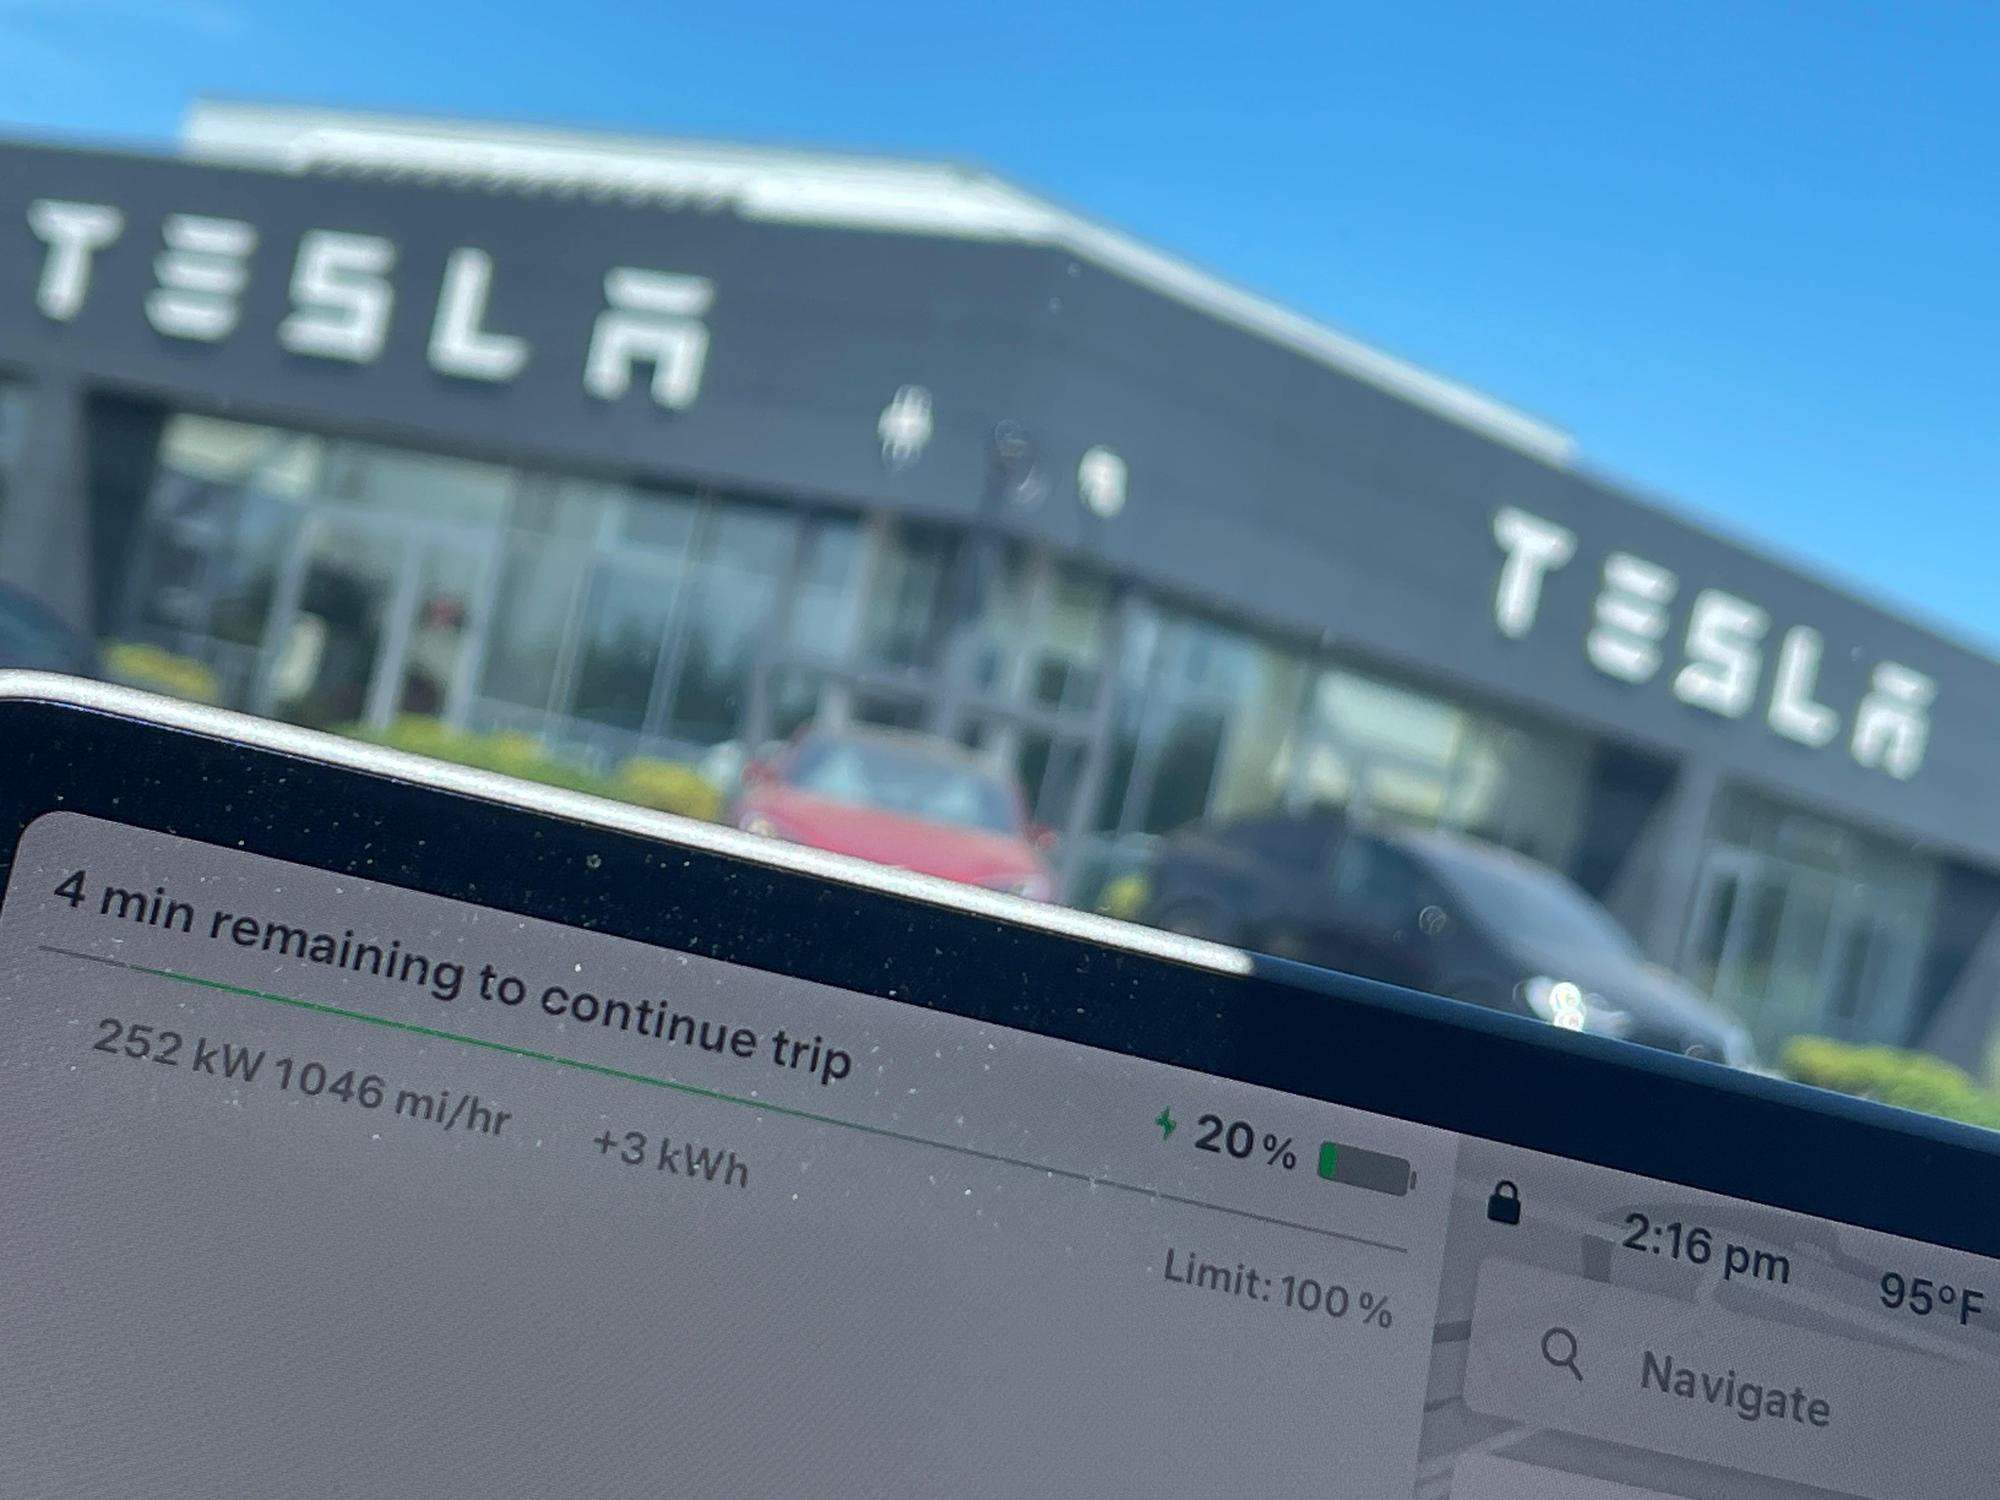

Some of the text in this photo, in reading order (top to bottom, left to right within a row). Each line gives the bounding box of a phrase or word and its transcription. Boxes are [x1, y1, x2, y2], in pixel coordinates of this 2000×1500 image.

[27, 198, 716, 410] TESLA
[1492, 506, 1938, 780] TESLA
[53, 868, 853, 1086] 4 min remaining to continue trip
[93, 1018, 512, 1139] 252 kW 1046 mi/hr
[593, 1129, 750, 1190] +3 kWh
[1621, 1212, 1791, 1285] 2:16 pm
[1879, 1271, 1983, 1327] 95°F
[1641, 1350, 1832, 1428] Navigate
